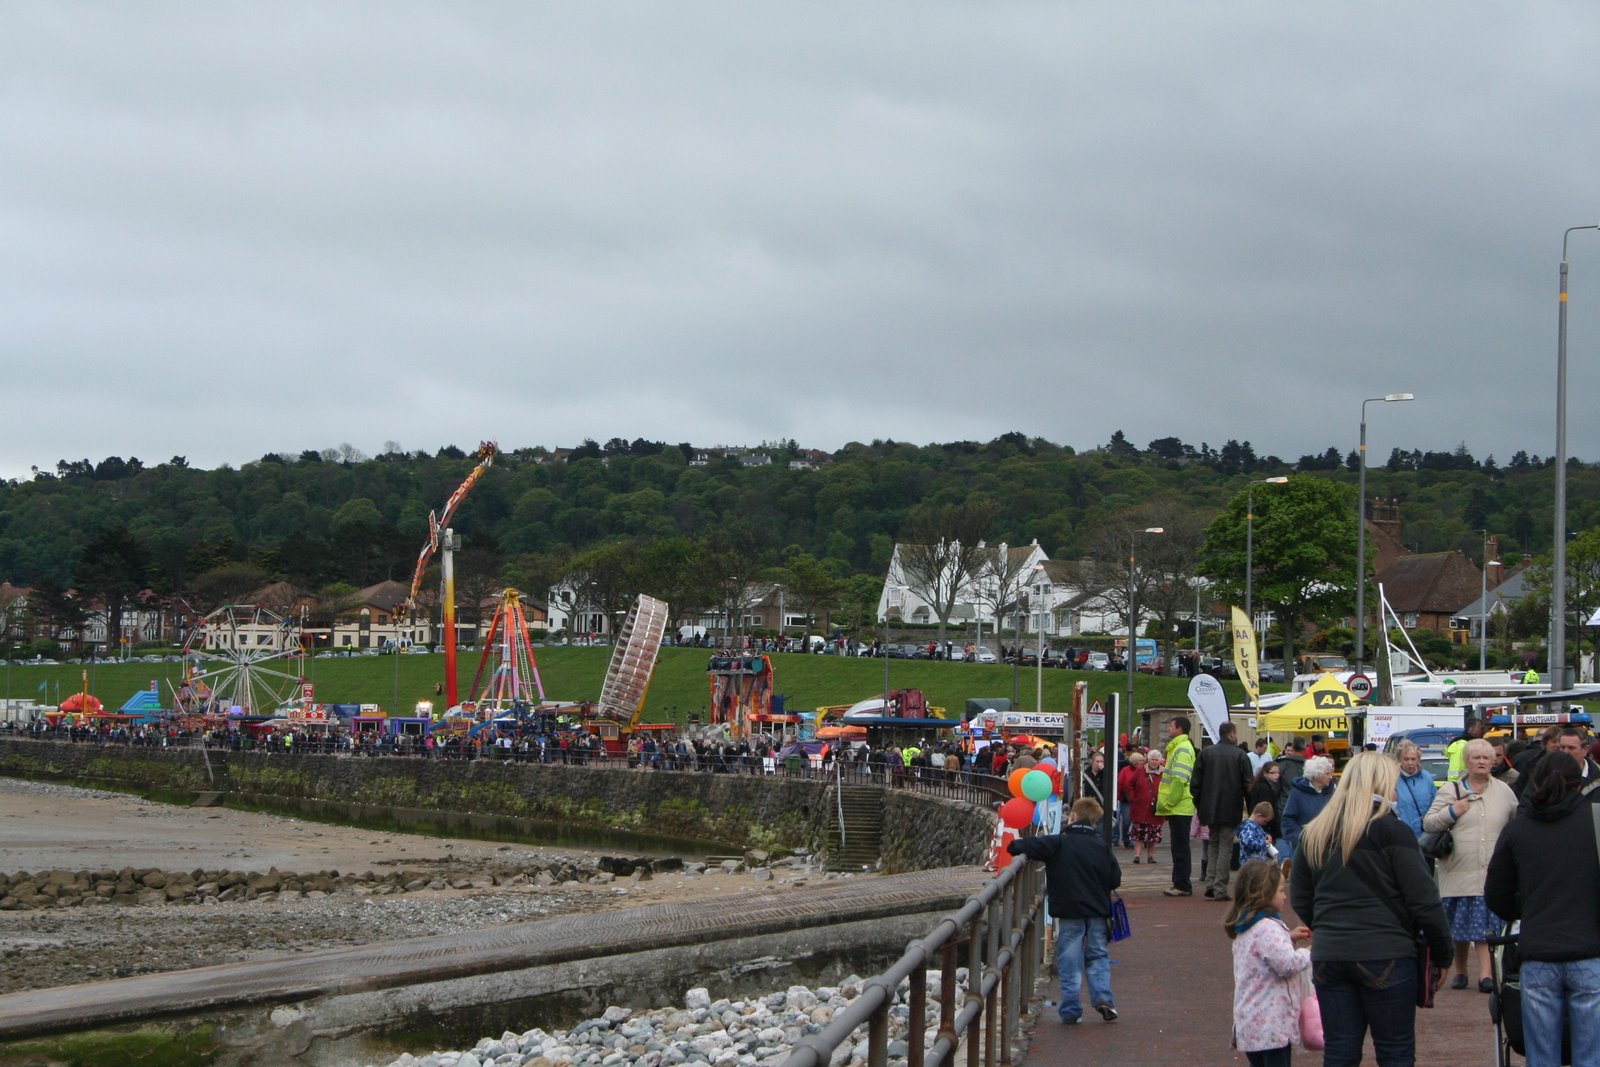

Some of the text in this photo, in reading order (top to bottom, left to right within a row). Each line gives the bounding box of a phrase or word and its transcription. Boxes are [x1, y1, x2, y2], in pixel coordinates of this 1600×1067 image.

[1236, 630, 1249, 640] AA
[1320, 694, 1346, 706] AA
[1298, 717, 1332, 730] JOIN
[1526, 715, 1557, 723] COASTGUARD
